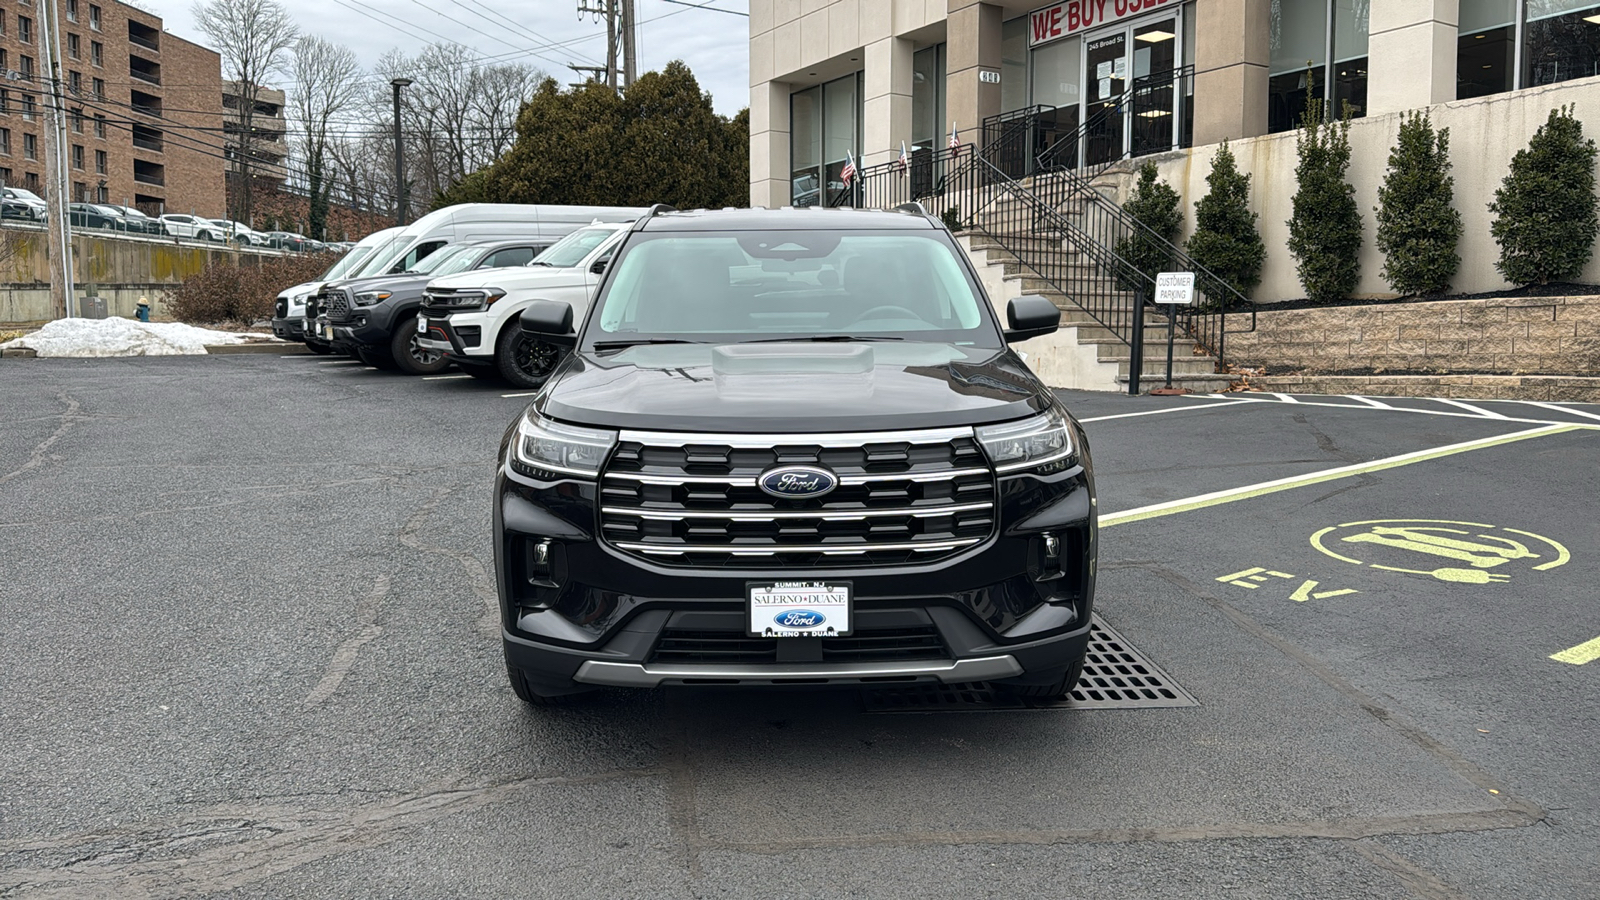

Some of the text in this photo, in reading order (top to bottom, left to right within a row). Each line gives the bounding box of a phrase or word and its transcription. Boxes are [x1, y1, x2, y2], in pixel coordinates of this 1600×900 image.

[1032, 7, 1062, 40] WE
[1068, 0, 1107, 32] BUY
[1089, 42, 1099, 51] 245
[1099, 38, 1116, 48] Broad
[1158, 277, 1191, 286] CUSTOMER
[1160, 289, 1187, 299] PARKING
[777, 473, 819, 491] Ford
[754, 595, 846, 605] SALERNO DUANE
[783, 612, 817, 626] Ford
